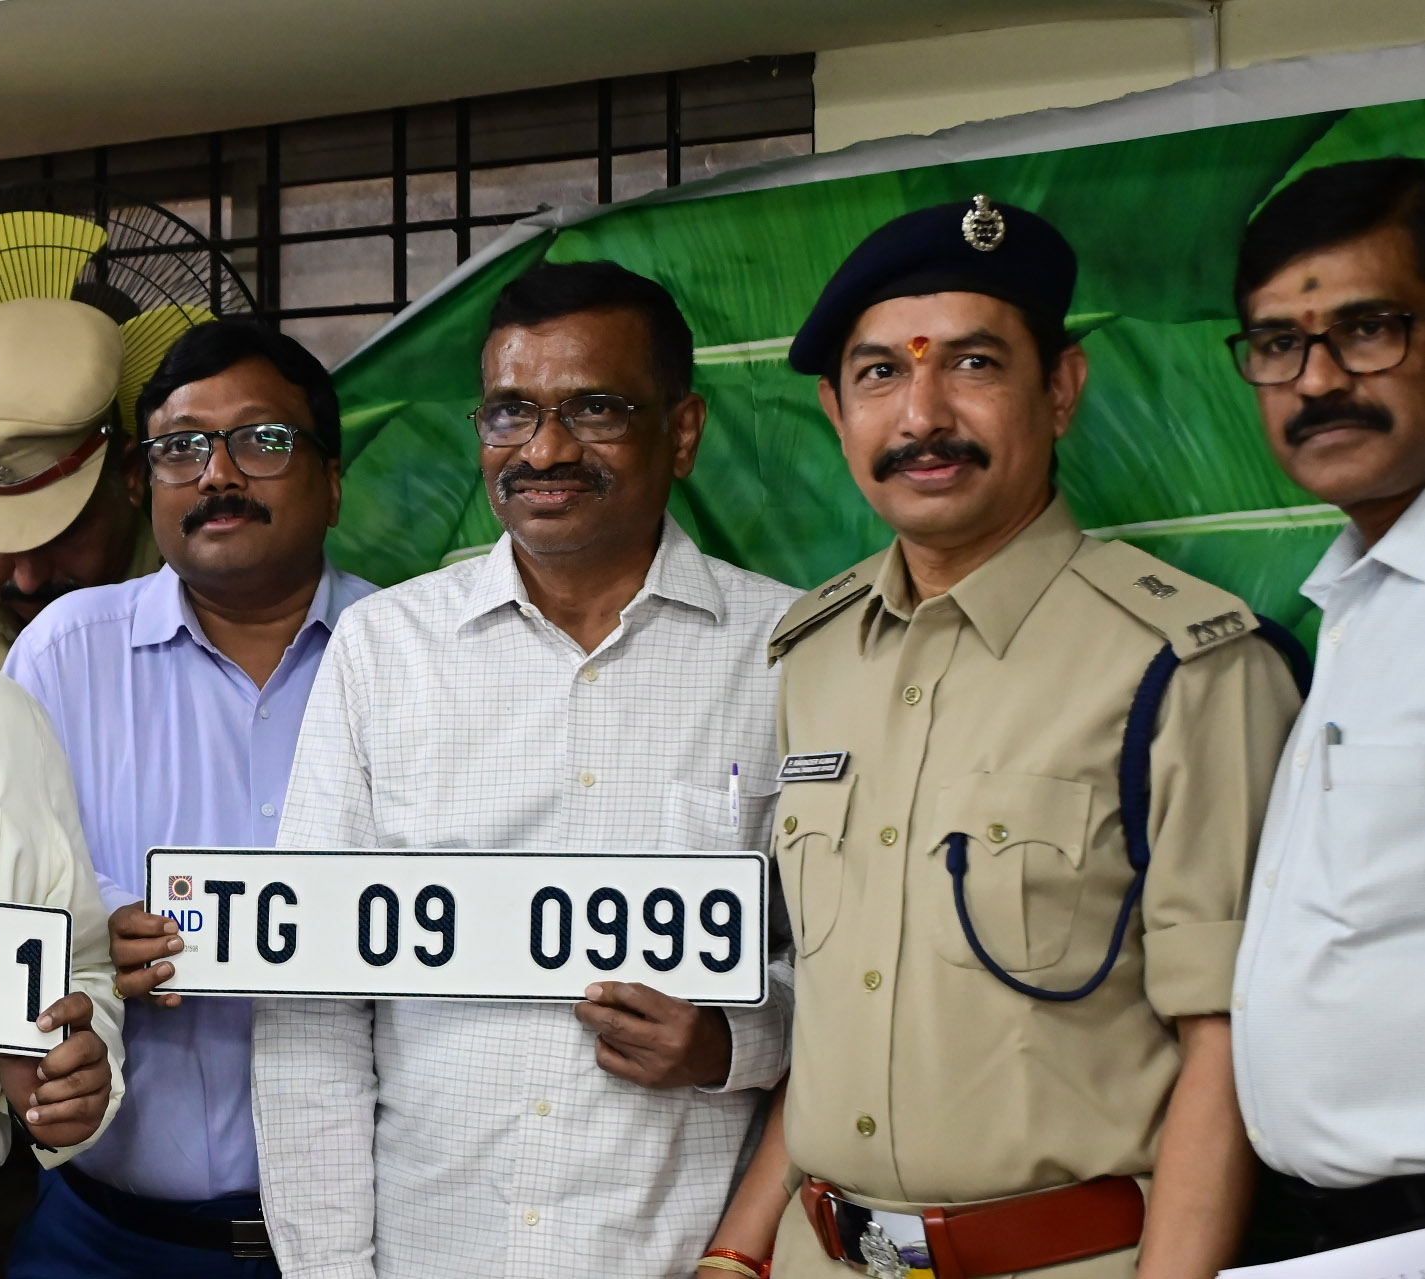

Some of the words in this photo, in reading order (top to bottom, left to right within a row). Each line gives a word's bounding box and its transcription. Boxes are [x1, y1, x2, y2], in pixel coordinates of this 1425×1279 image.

[204, 880, 298, 965] TG
[357, 883, 457, 969] 09
[528, 885, 743, 974] 0999
